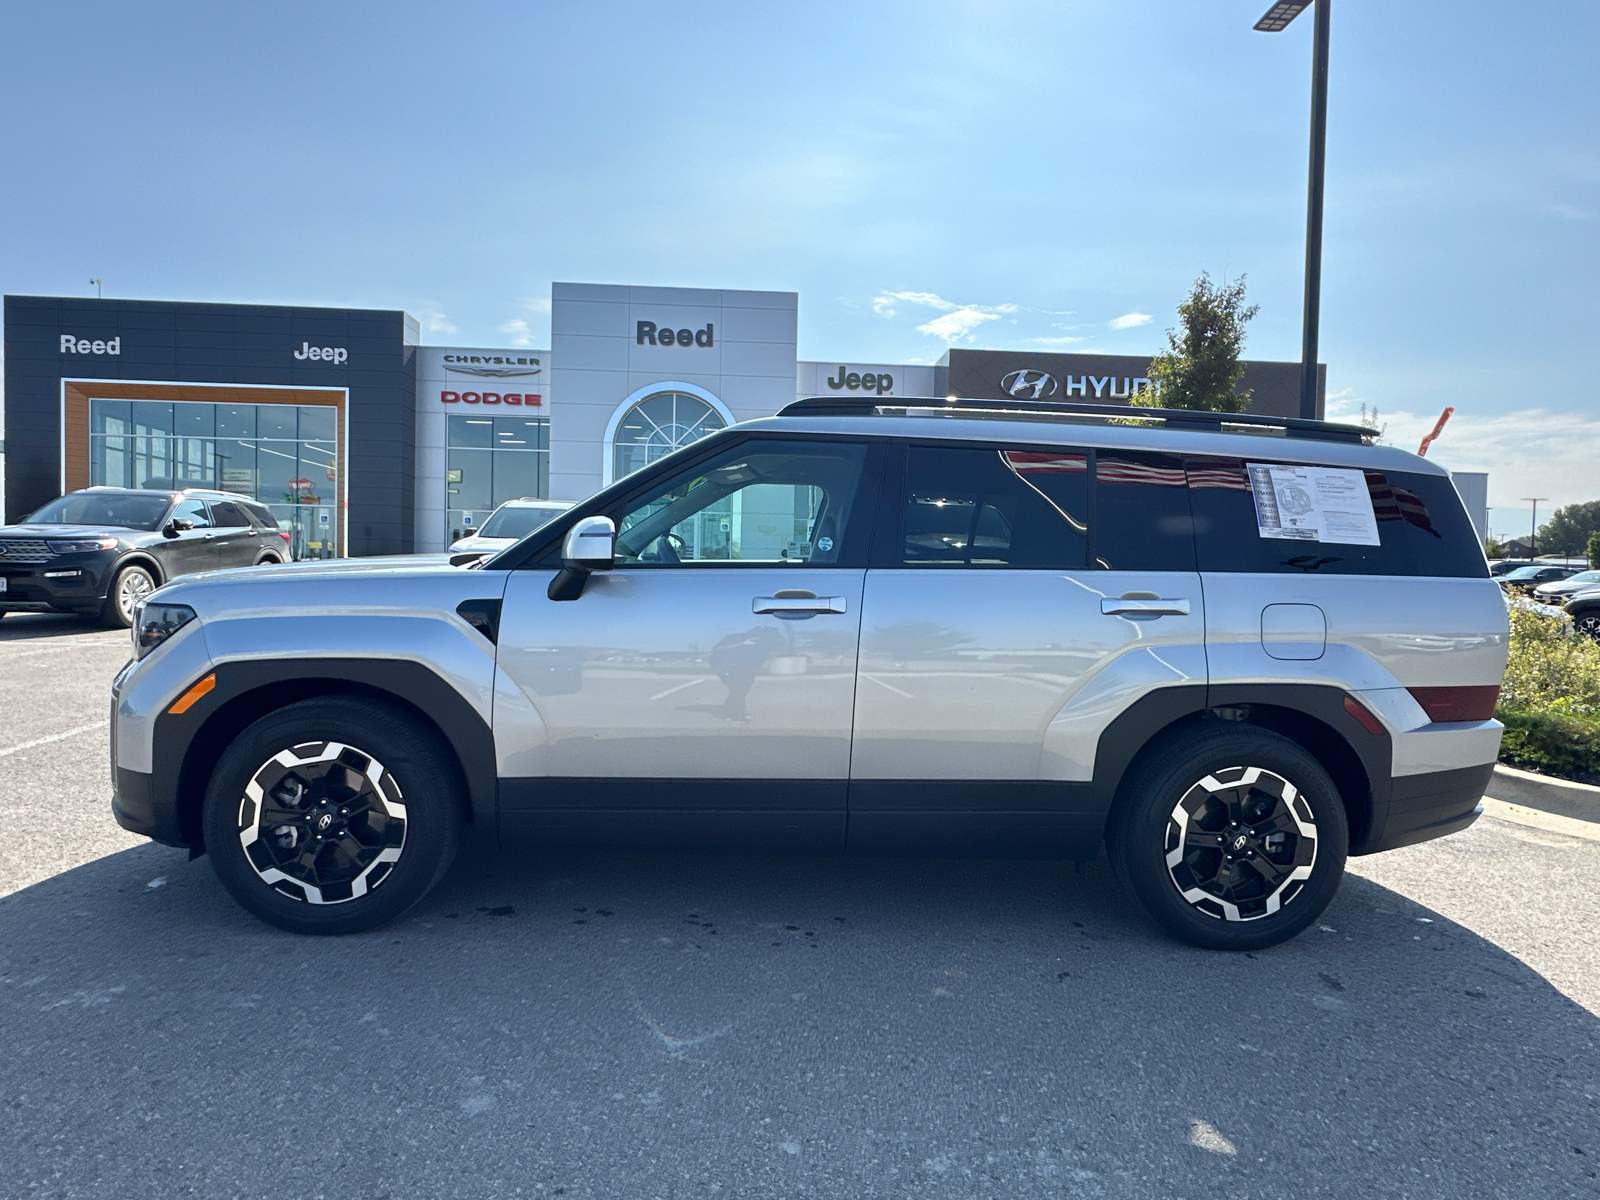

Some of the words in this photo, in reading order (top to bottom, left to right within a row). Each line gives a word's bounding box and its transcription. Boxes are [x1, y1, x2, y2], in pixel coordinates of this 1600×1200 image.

[60, 334, 120, 355] Reed
[636, 320, 714, 347] Reed
[294, 342, 348, 365] Jeep
[443, 354, 541, 367] CHRYSLER
[827, 365, 894, 396] Jeep
[440, 390, 542, 407] DODGE
